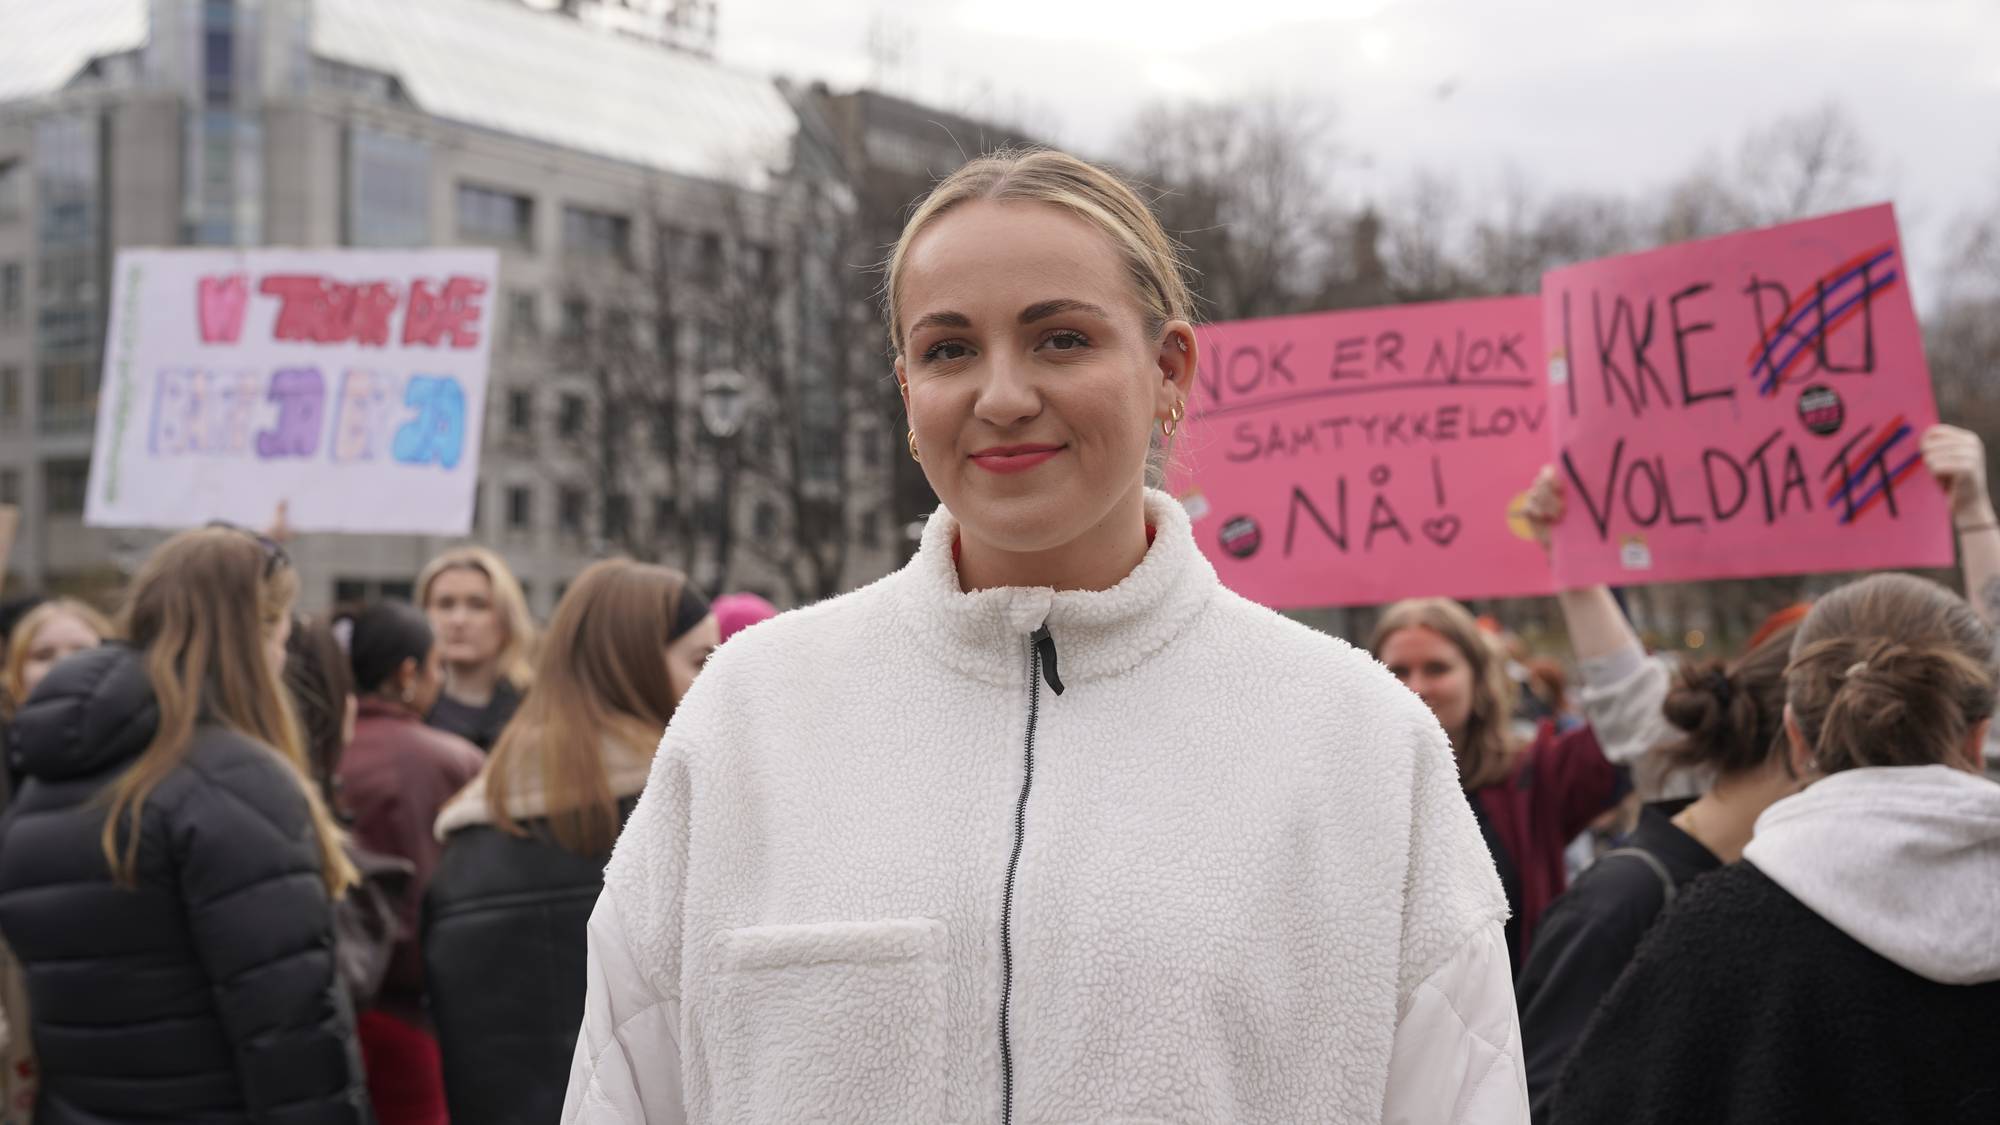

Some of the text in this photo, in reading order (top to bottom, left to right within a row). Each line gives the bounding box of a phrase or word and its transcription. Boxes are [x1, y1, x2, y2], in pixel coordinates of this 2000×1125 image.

[1330, 331, 1406, 380] ER
[1424, 329, 1528, 384] NOK
[1226, 404, 1547, 462] SAMTYKKELOV
